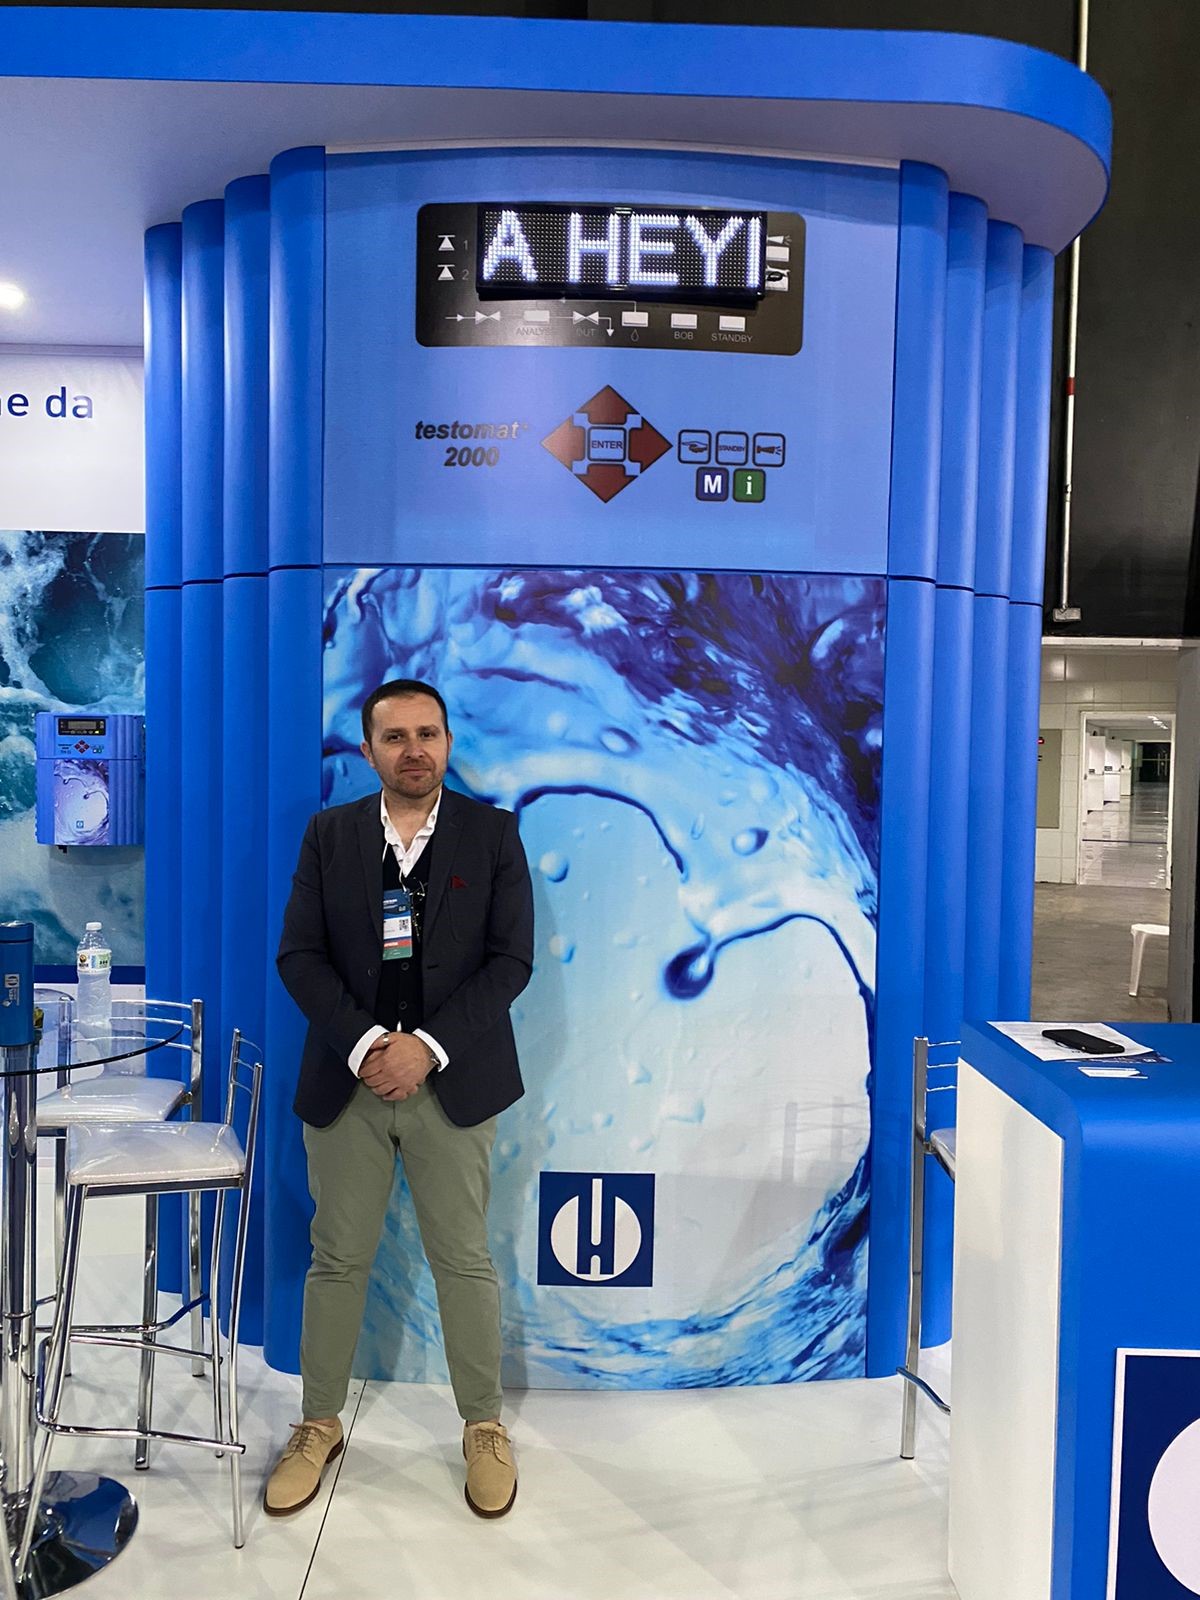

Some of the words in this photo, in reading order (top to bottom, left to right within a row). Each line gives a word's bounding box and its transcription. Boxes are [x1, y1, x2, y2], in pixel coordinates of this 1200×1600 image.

[463, 240, 468, 250] 1
[483, 209, 538, 281] A
[462, 269, 469, 280] 2
[673, 331, 694, 340] BOB
[711, 332, 753, 343] STANDBY
[45, 386, 93, 418] da
[591, 440, 623, 449] ENTER
[444, 446, 499, 467] 2000
[704, 474, 722, 494] M
[746, 475, 753, 495] i
